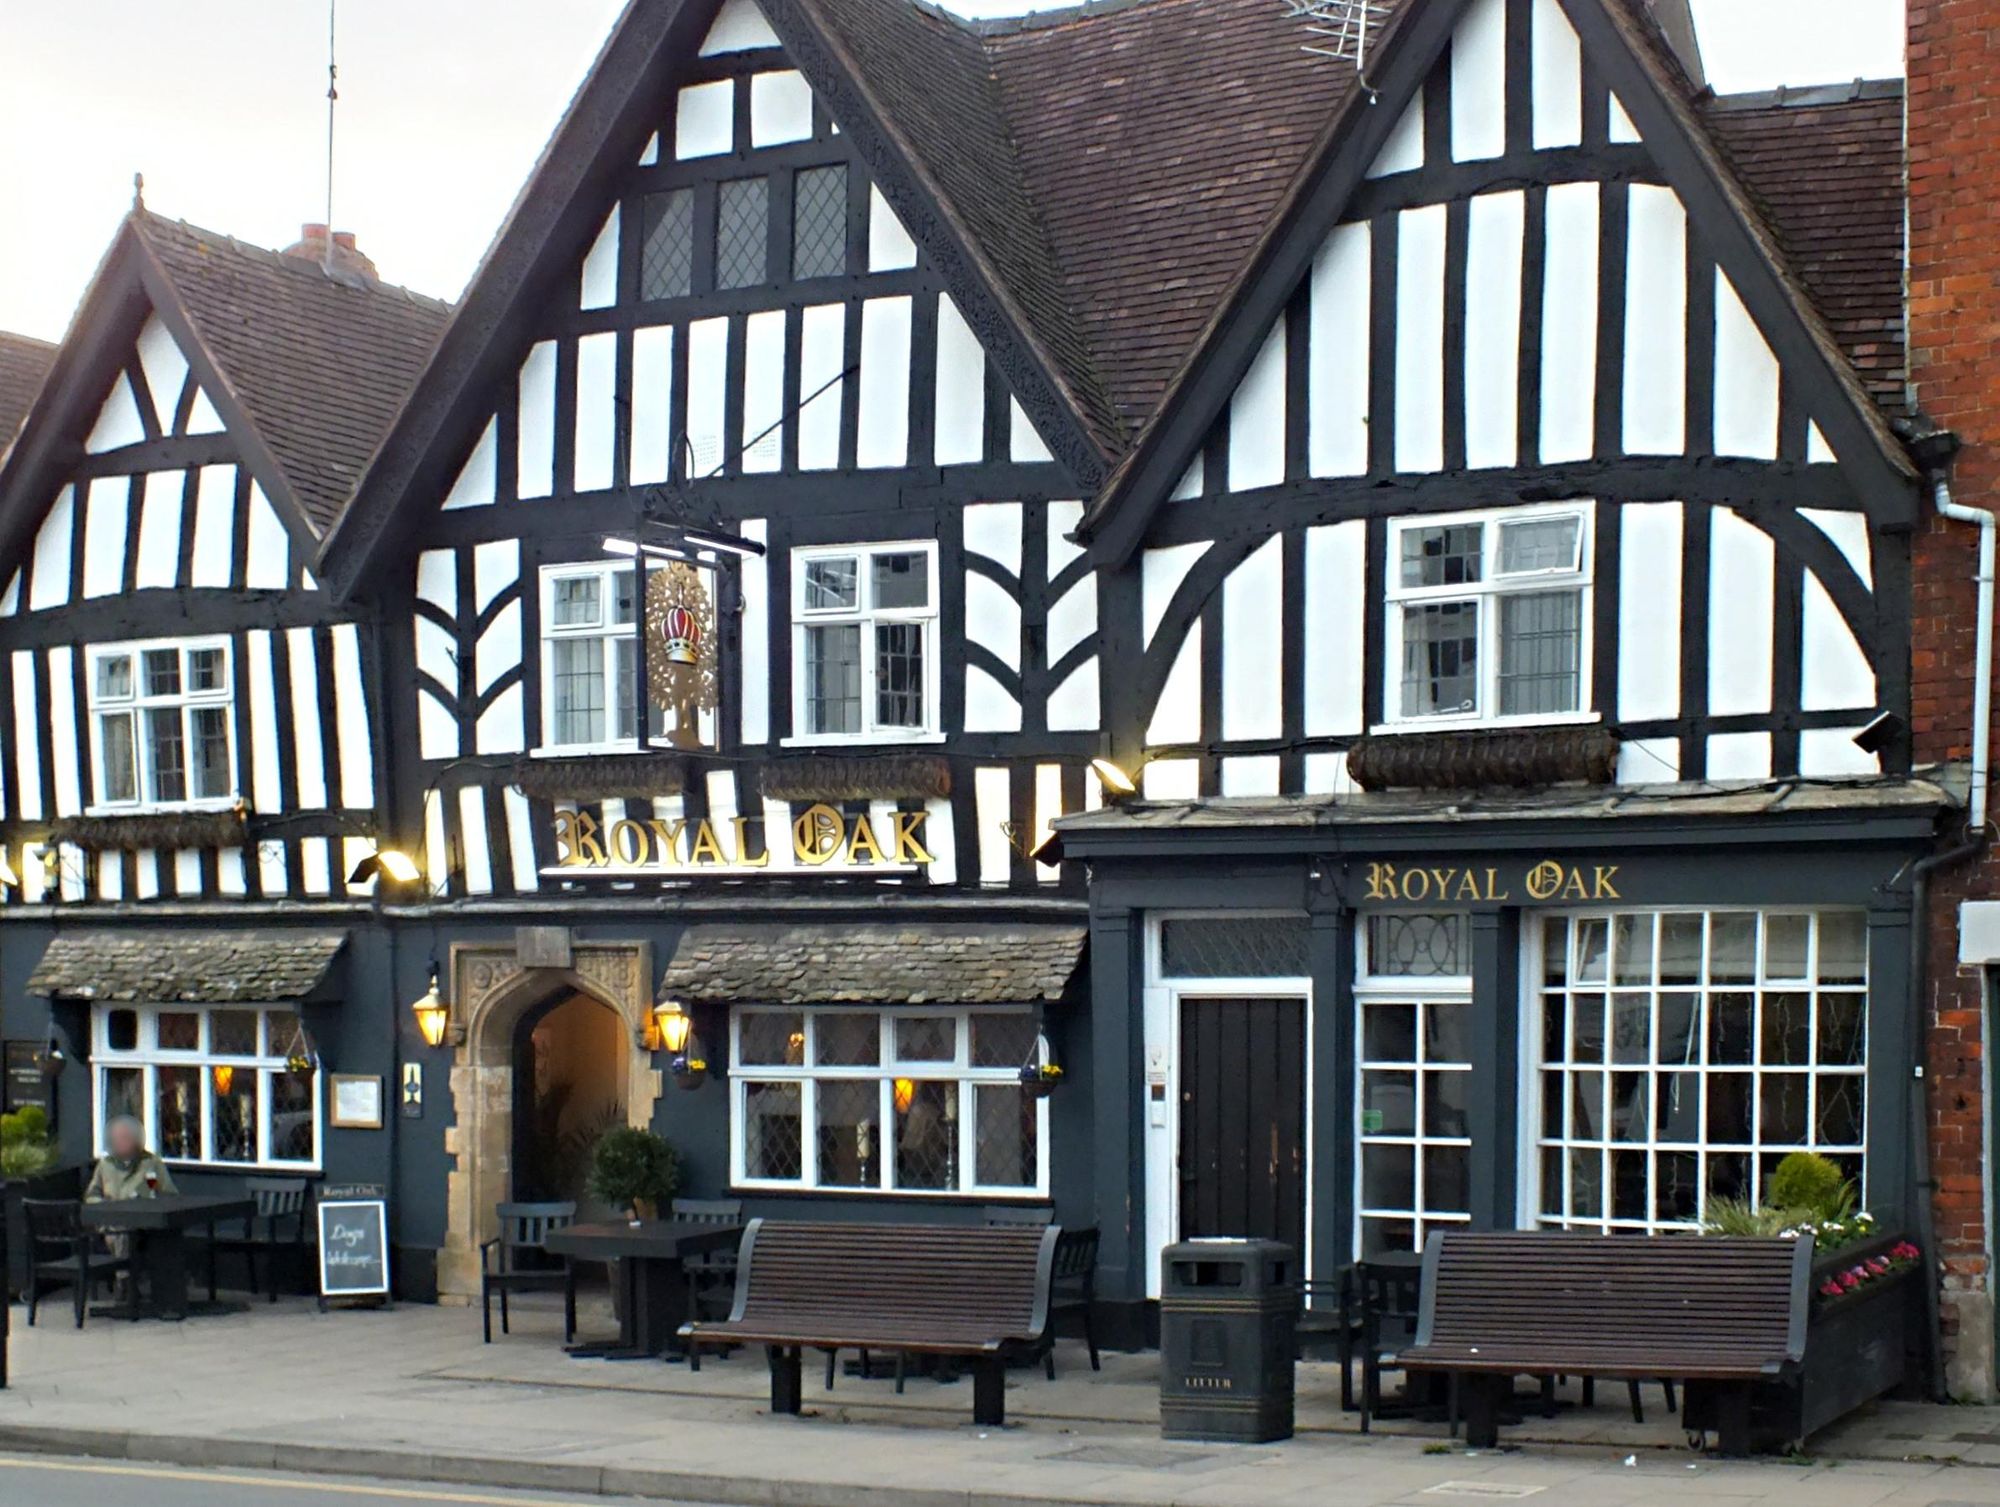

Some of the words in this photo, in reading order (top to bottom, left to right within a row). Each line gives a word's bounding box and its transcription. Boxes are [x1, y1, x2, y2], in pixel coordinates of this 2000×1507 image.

[555, 809, 769, 868] ROYAL
[794, 803, 936, 866] OAK
[1364, 861, 1509, 901] ROYAL
[1526, 859, 1621, 900] OAK
